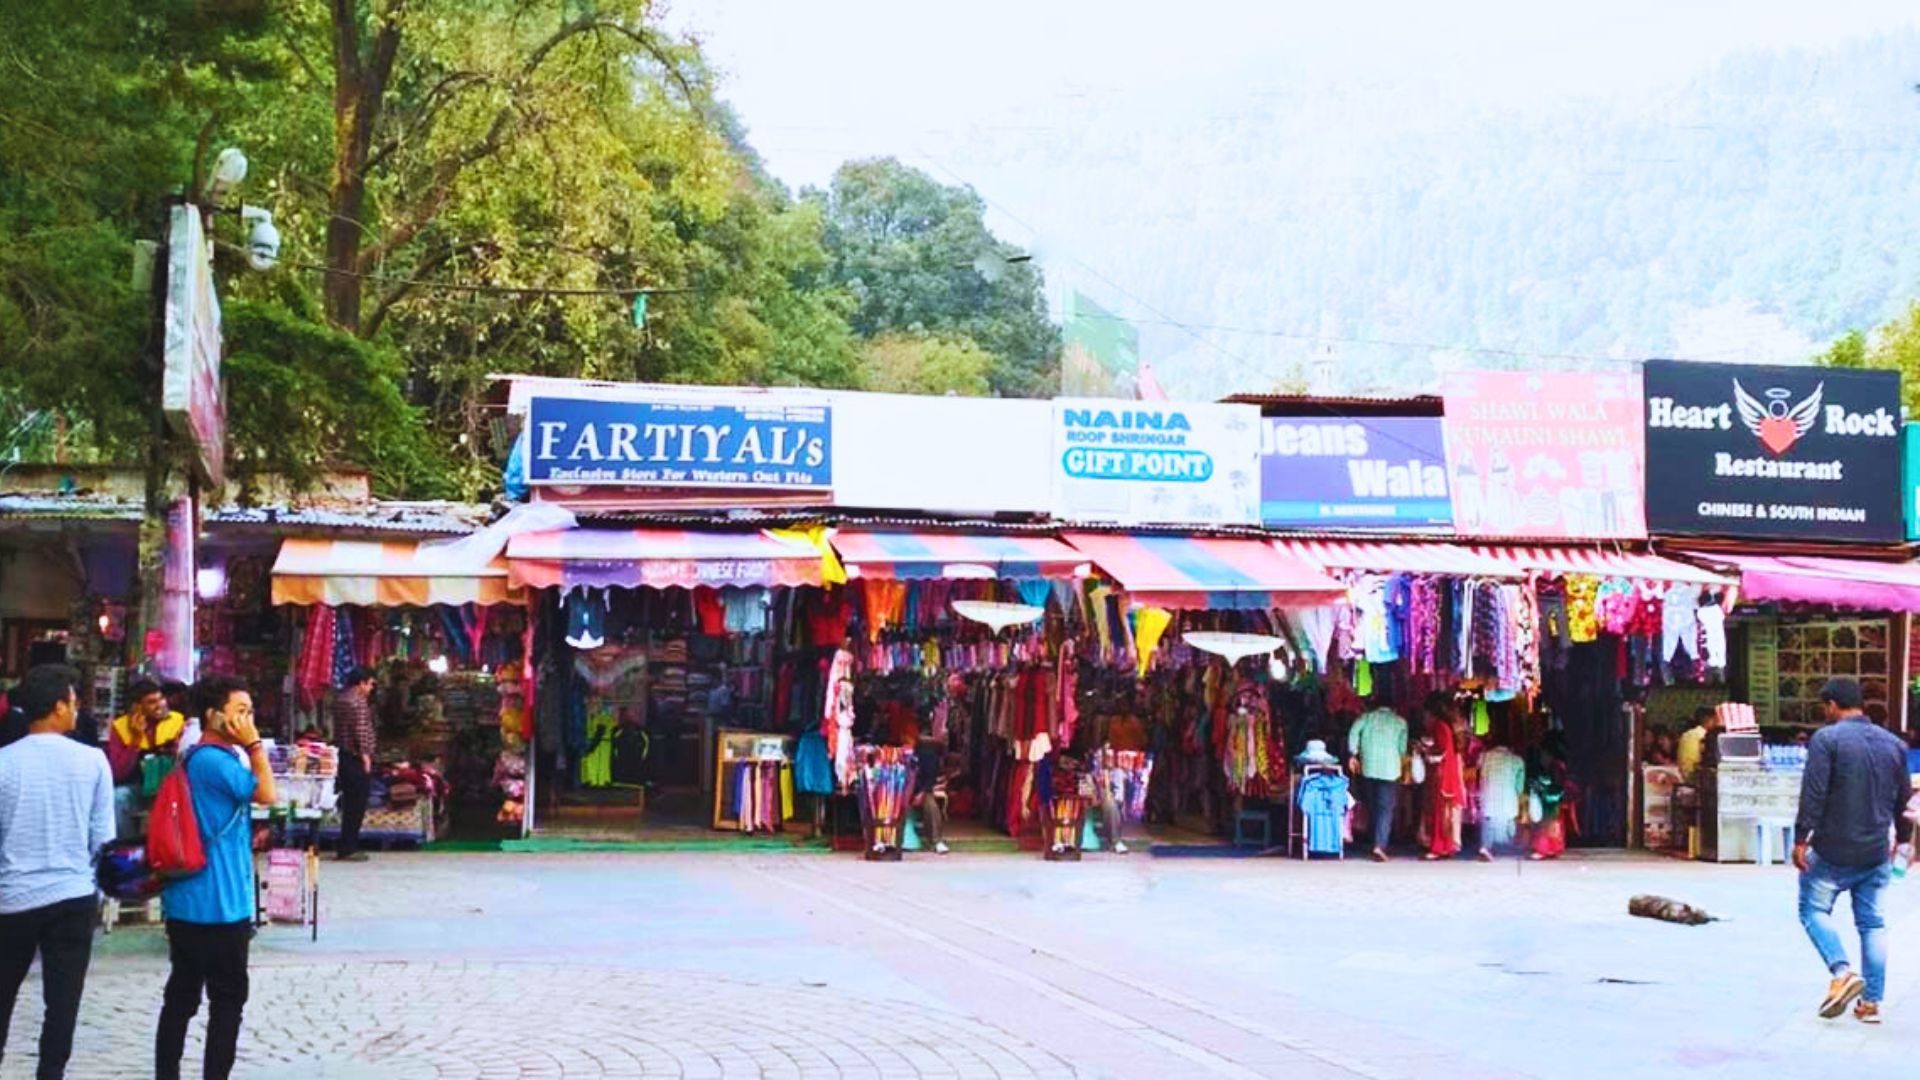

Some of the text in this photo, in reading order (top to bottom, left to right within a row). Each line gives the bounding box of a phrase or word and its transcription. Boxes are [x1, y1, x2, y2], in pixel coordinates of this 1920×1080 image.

[1064, 409, 1191, 431] NAINA
[1469, 400, 1607, 421] SHAWL WALA
[1649, 397, 1897, 436] Heart Rock
[537, 421, 823, 467] FARTIYAL's
[1067, 431, 1185, 445] ROOP SHRINGAR
[1260, 419, 1368, 456] Jeans
[662, 469, 687, 480] For
[1067, 449, 1207, 478] GIFT POINT
[1714, 452, 1842, 480] Restaurant
[1348, 459, 1448, 497] Wala
[1697, 502, 1866, 522] CHINESE & SOUTH INDIAN
